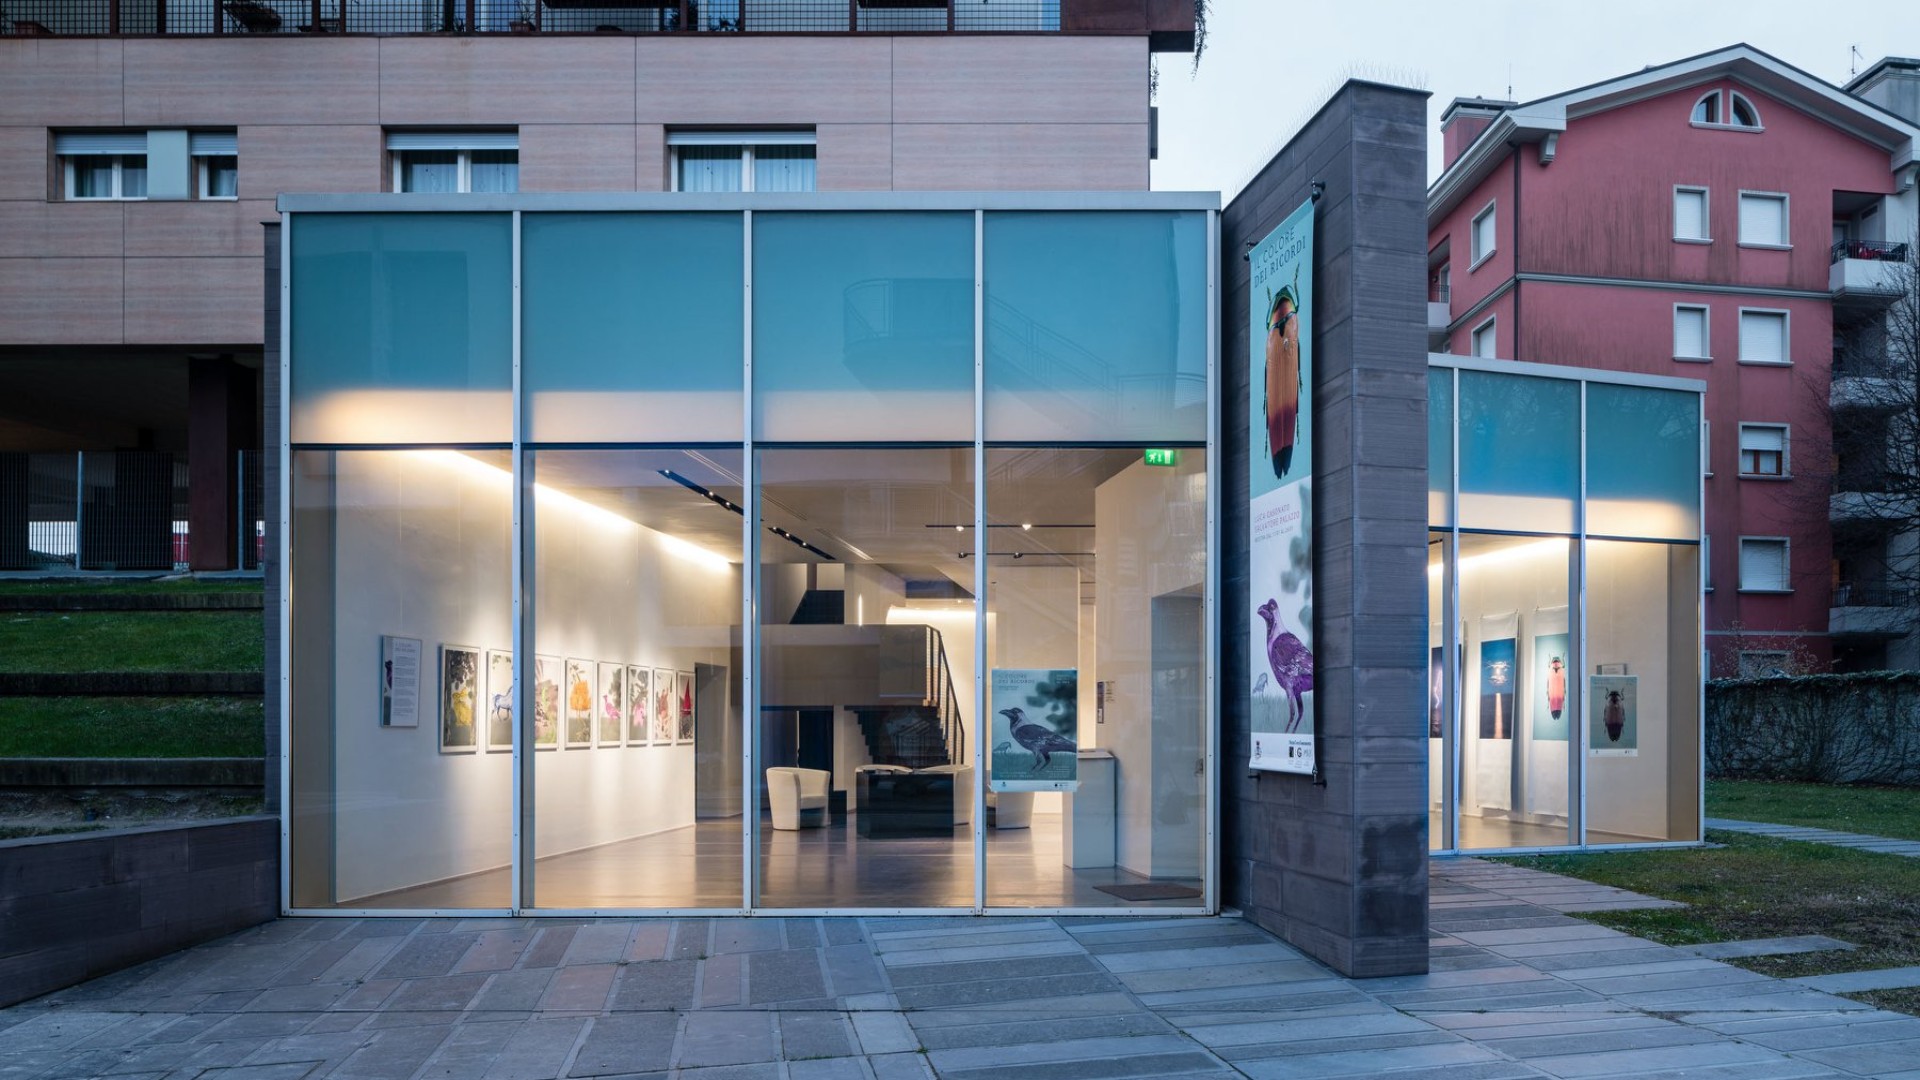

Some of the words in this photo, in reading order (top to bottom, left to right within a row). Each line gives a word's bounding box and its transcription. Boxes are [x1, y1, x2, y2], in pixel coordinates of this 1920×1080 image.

[1254, 267, 1267, 289] DEI
[1271, 236, 1305, 275] RICORDI
[1263, 226, 1295, 263] COLORE
